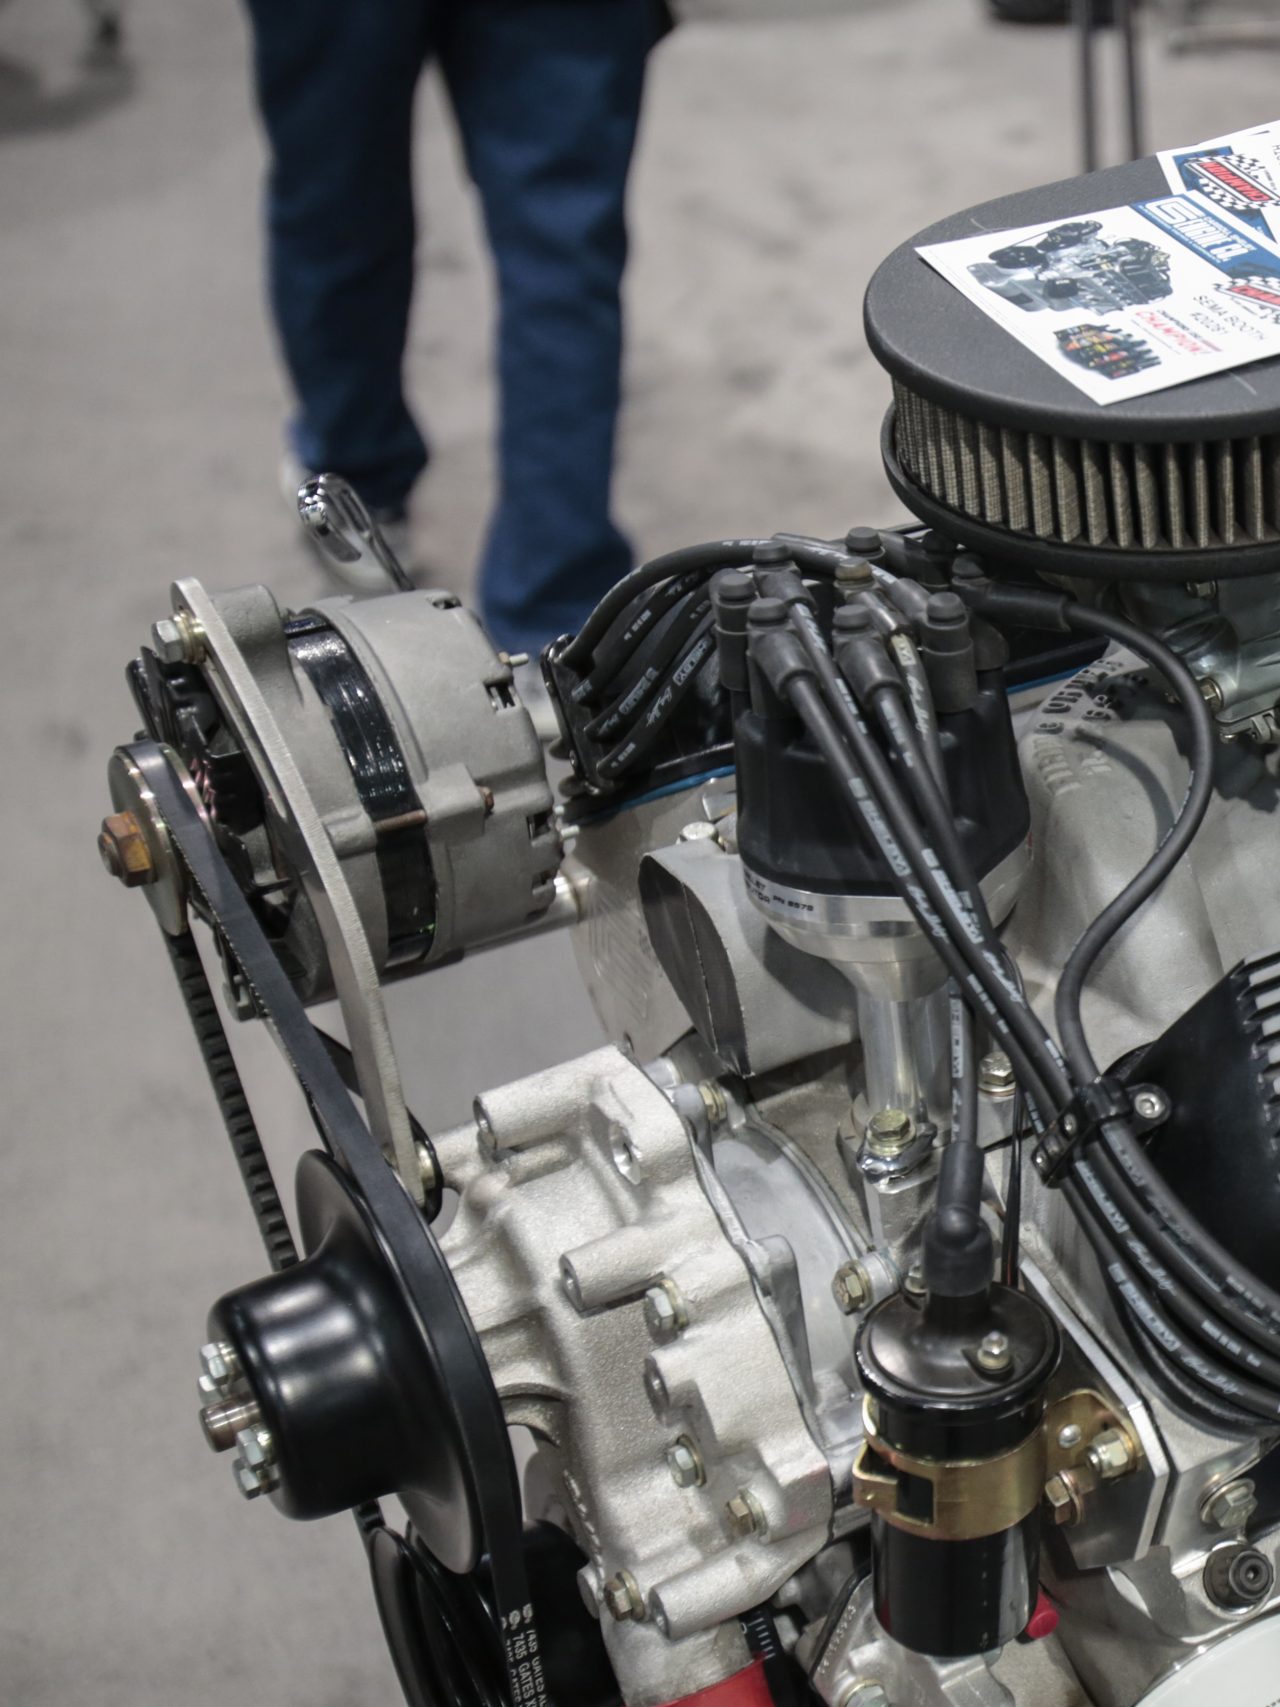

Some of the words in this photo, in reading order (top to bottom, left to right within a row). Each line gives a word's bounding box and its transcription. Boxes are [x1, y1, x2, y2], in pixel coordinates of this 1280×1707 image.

[1199, 161, 1274, 201] CHAMPION
[512, 1633, 528, 1660] 7435
[518, 1662, 536, 1699] GATES
